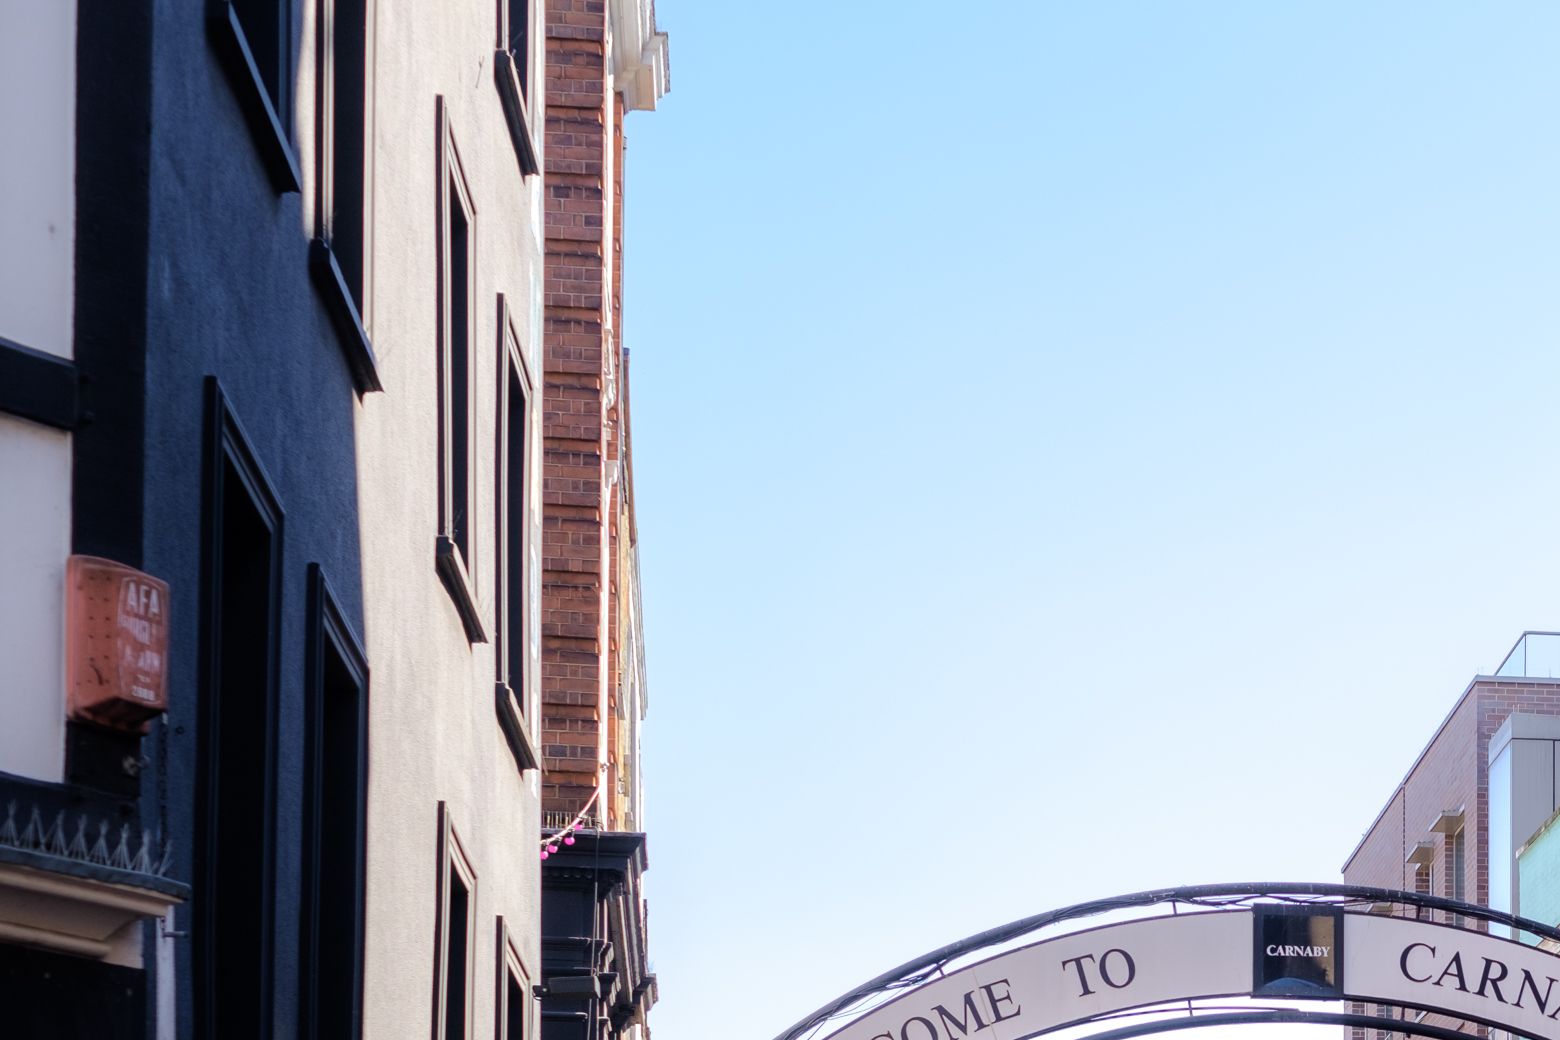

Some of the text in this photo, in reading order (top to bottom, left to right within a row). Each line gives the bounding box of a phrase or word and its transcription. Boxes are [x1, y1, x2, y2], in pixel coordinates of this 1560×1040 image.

[127, 581, 161, 616] AFA
[1266, 944, 1331, 958] CARNABY
[1061, 948, 1137, 998] TO
